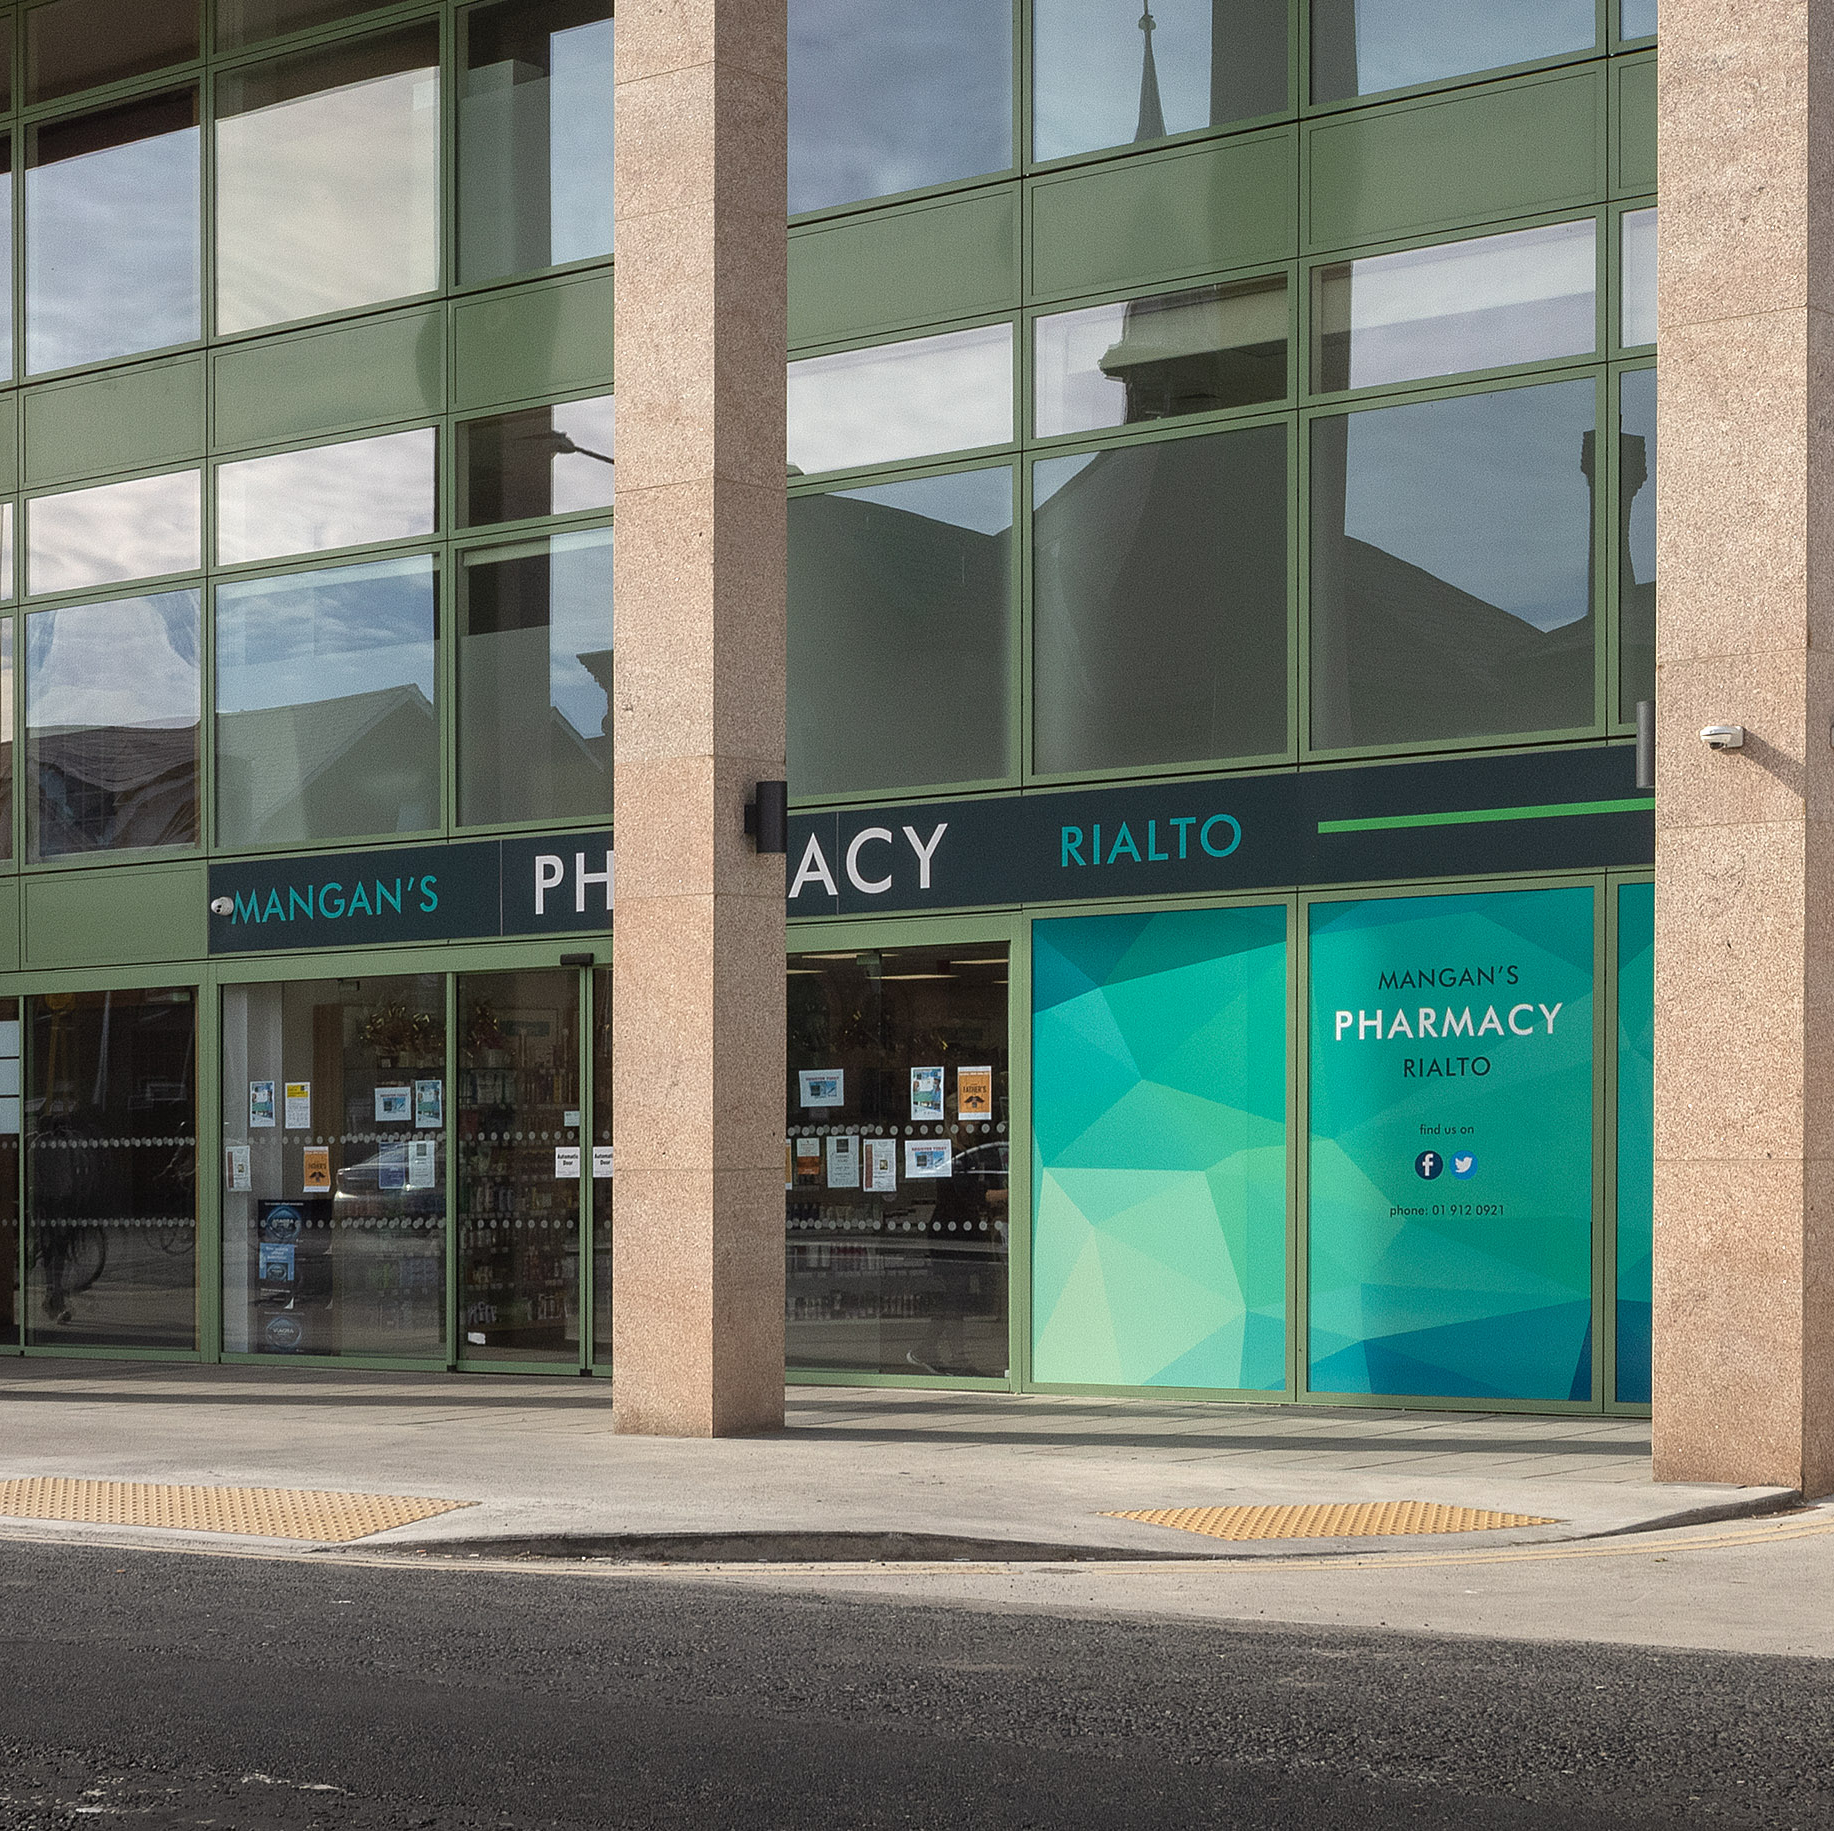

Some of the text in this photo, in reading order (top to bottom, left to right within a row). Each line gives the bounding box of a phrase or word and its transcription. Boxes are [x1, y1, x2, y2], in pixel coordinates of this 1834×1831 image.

[230, 813, 1243, 926] MANGAN'S PHACY RIALTO
[1378, 965, 1519, 990] MANGAN'S
[1335, 1002, 1563, 1041] PHARMACY
[1403, 1056, 1491, 1078] RIALTO
[1419, 1124, 1475, 1135] find us on
[1389, 1204, 1504, 1218] phone: 01 912 0921
